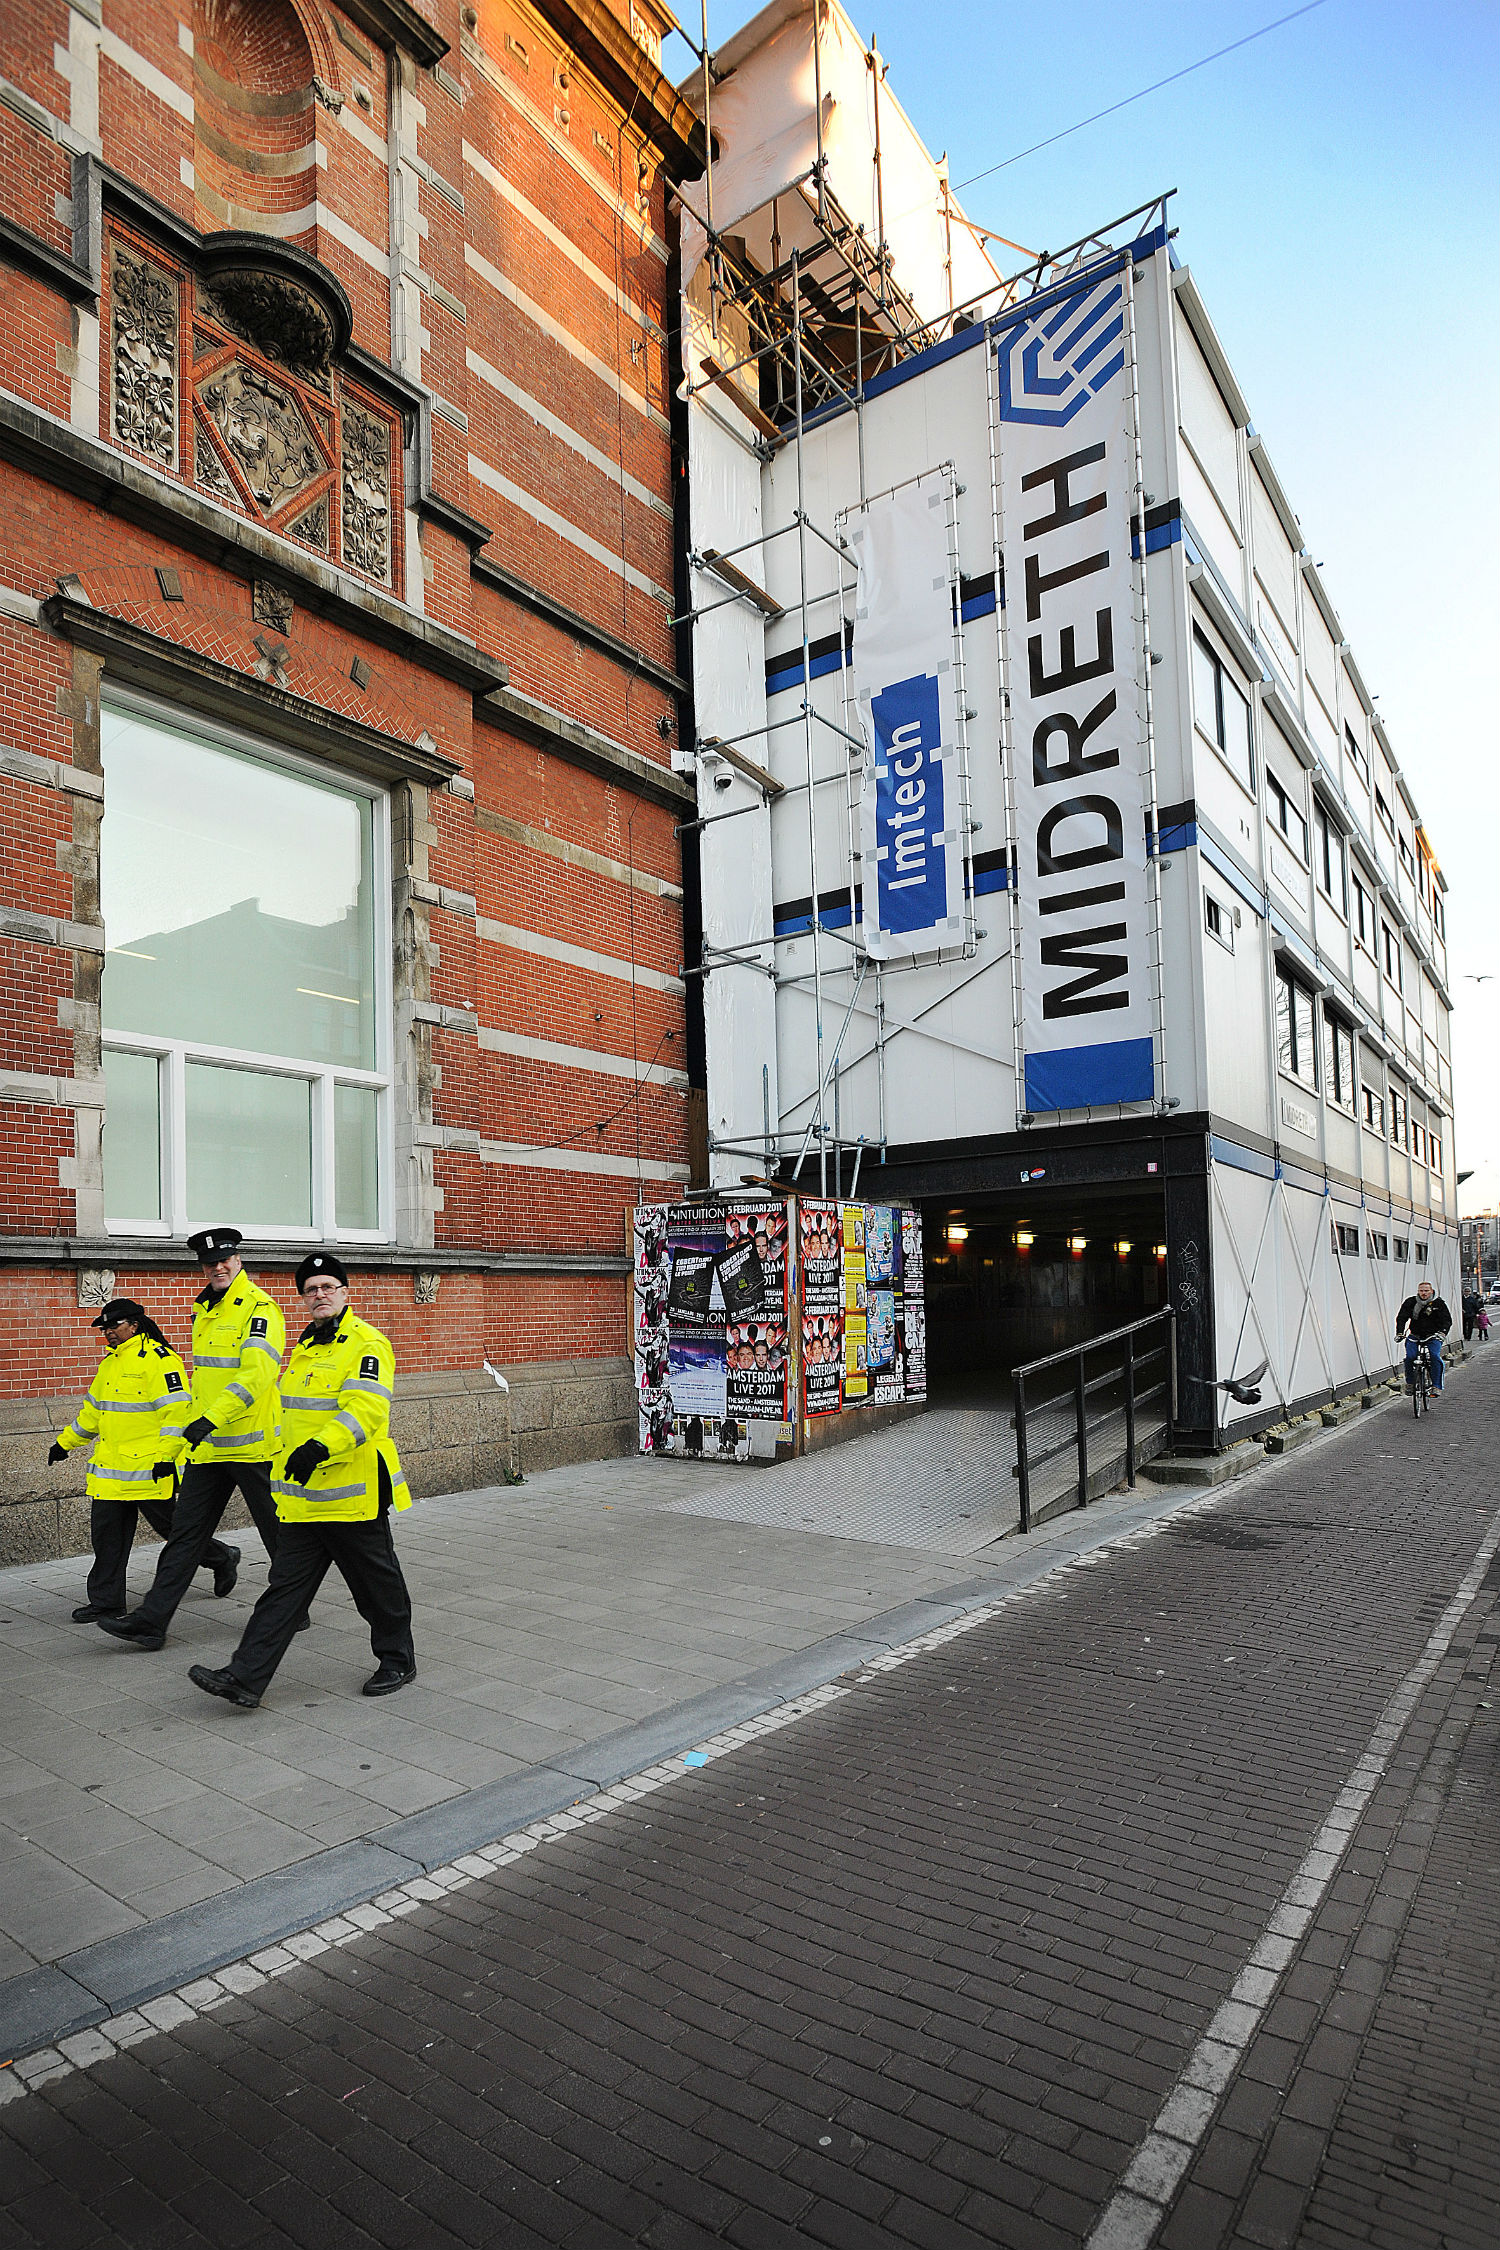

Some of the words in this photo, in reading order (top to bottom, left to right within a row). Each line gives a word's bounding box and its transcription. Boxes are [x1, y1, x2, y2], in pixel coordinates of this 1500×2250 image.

[1021, 440, 1130, 1020] MIDRETH
[886, 720, 927, 890] Imtech
[677, 1208, 725, 1220] INTUITION
[727, 1205, 733, 1214] 5
[733, 1203, 766, 1214] FEBRUARI
[766, 1202, 782, 1212] 2011
[804, 1260, 839, 1272] AMSTERDAM
[808, 1272, 822, 1284] LIVE
[822, 1272, 835, 1283] 2011
[768, 1312, 783, 1322] 2011
[805, 1361, 840, 1377] AMSTERDAM
[726, 1369, 785, 1383] AMSTERDAM
[876, 1374, 903, 1384] LEGENDS
[733, 1382, 754, 1395] LIVE
[757, 1384, 776, 1395] 2011
[810, 1377, 823, 1389] LIVE
[874, 1385, 905, 1402] ESCAPE
[754, 1399, 783, 1407] AMSTERDAM
[728, 1404, 783, 1415] WWW.ADAM-LIVE.NL
